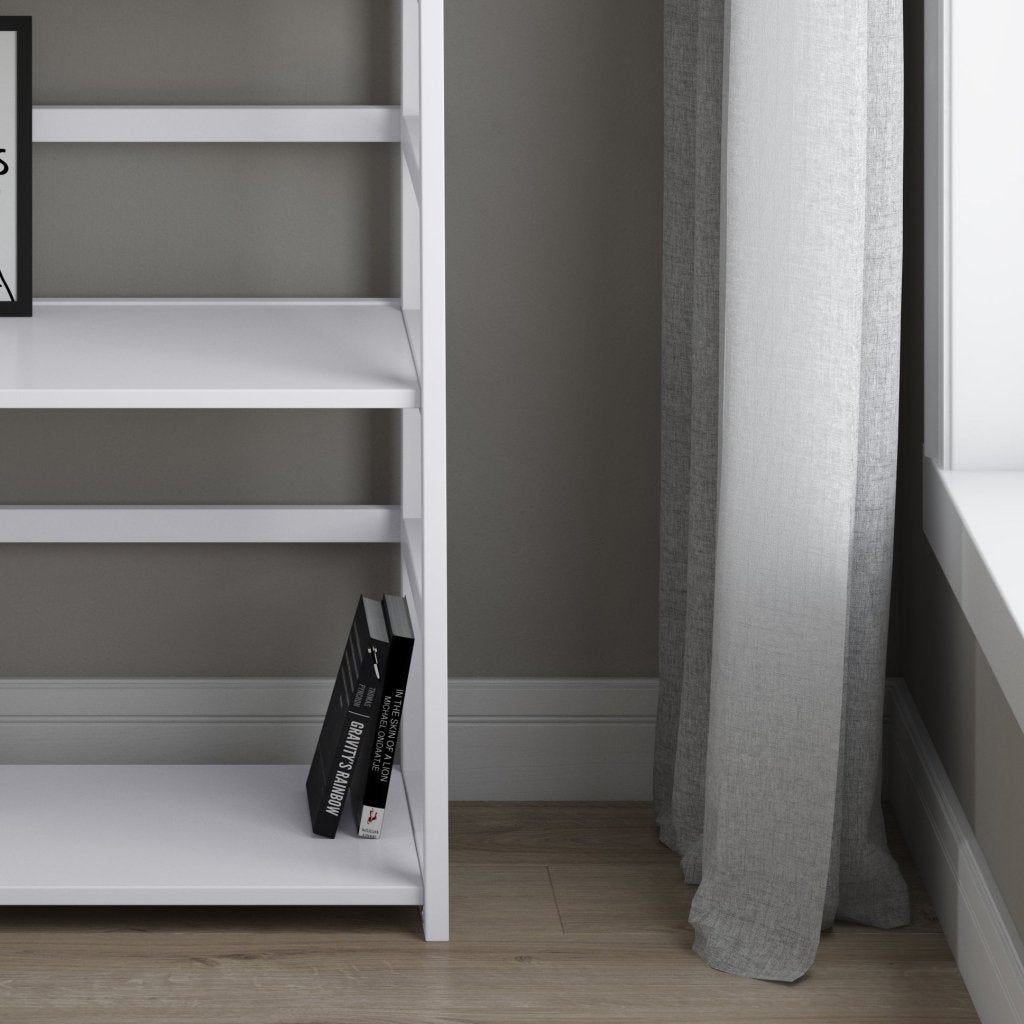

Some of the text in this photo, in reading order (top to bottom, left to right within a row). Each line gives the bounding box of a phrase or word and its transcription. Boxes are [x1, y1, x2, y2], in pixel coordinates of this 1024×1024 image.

[394, 689, 404, 698] IN
[391, 699, 402, 717] THE
[371, 695, 391, 772] MICHAEL ONDAATJE
[387, 719, 399, 739] SKIN
[386, 740, 395, 753] OF
[325, 721, 364, 816] GRAVITY'S RAINBOW
[380, 762, 390, 783] LION
